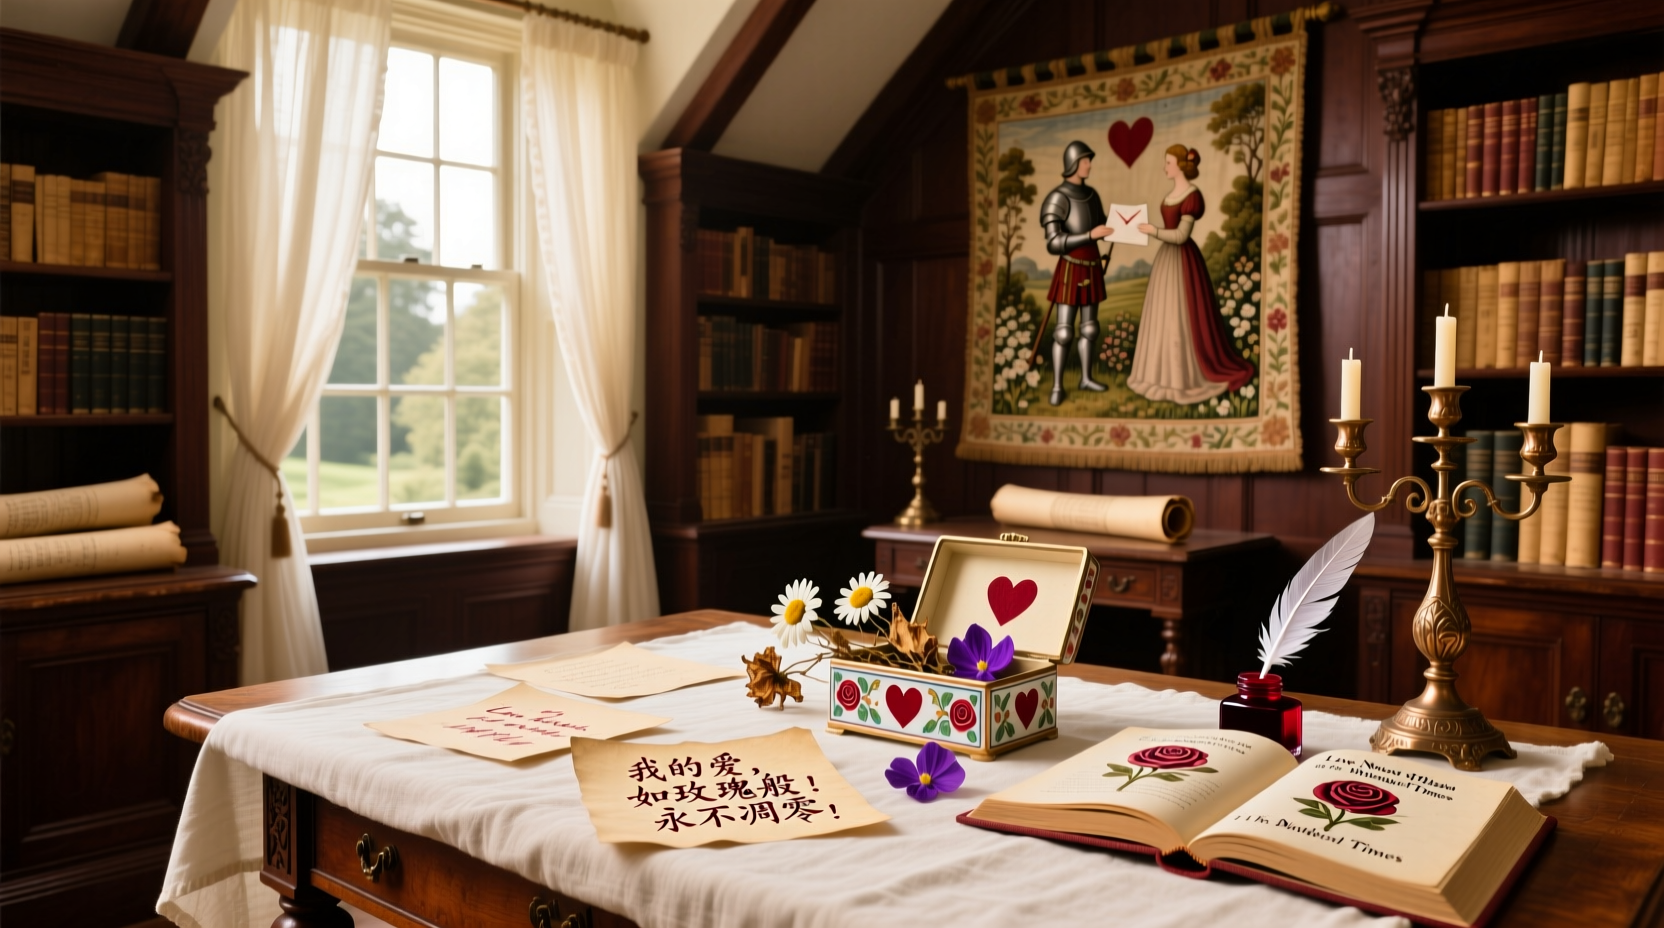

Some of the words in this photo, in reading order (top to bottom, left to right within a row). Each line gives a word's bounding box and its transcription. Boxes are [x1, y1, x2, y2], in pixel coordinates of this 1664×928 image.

[628, 752, 761, 783] 我的爱，
[627, 773, 820, 808] 如玫瑰般！
[655, 796, 841, 833] 永不凋零！
